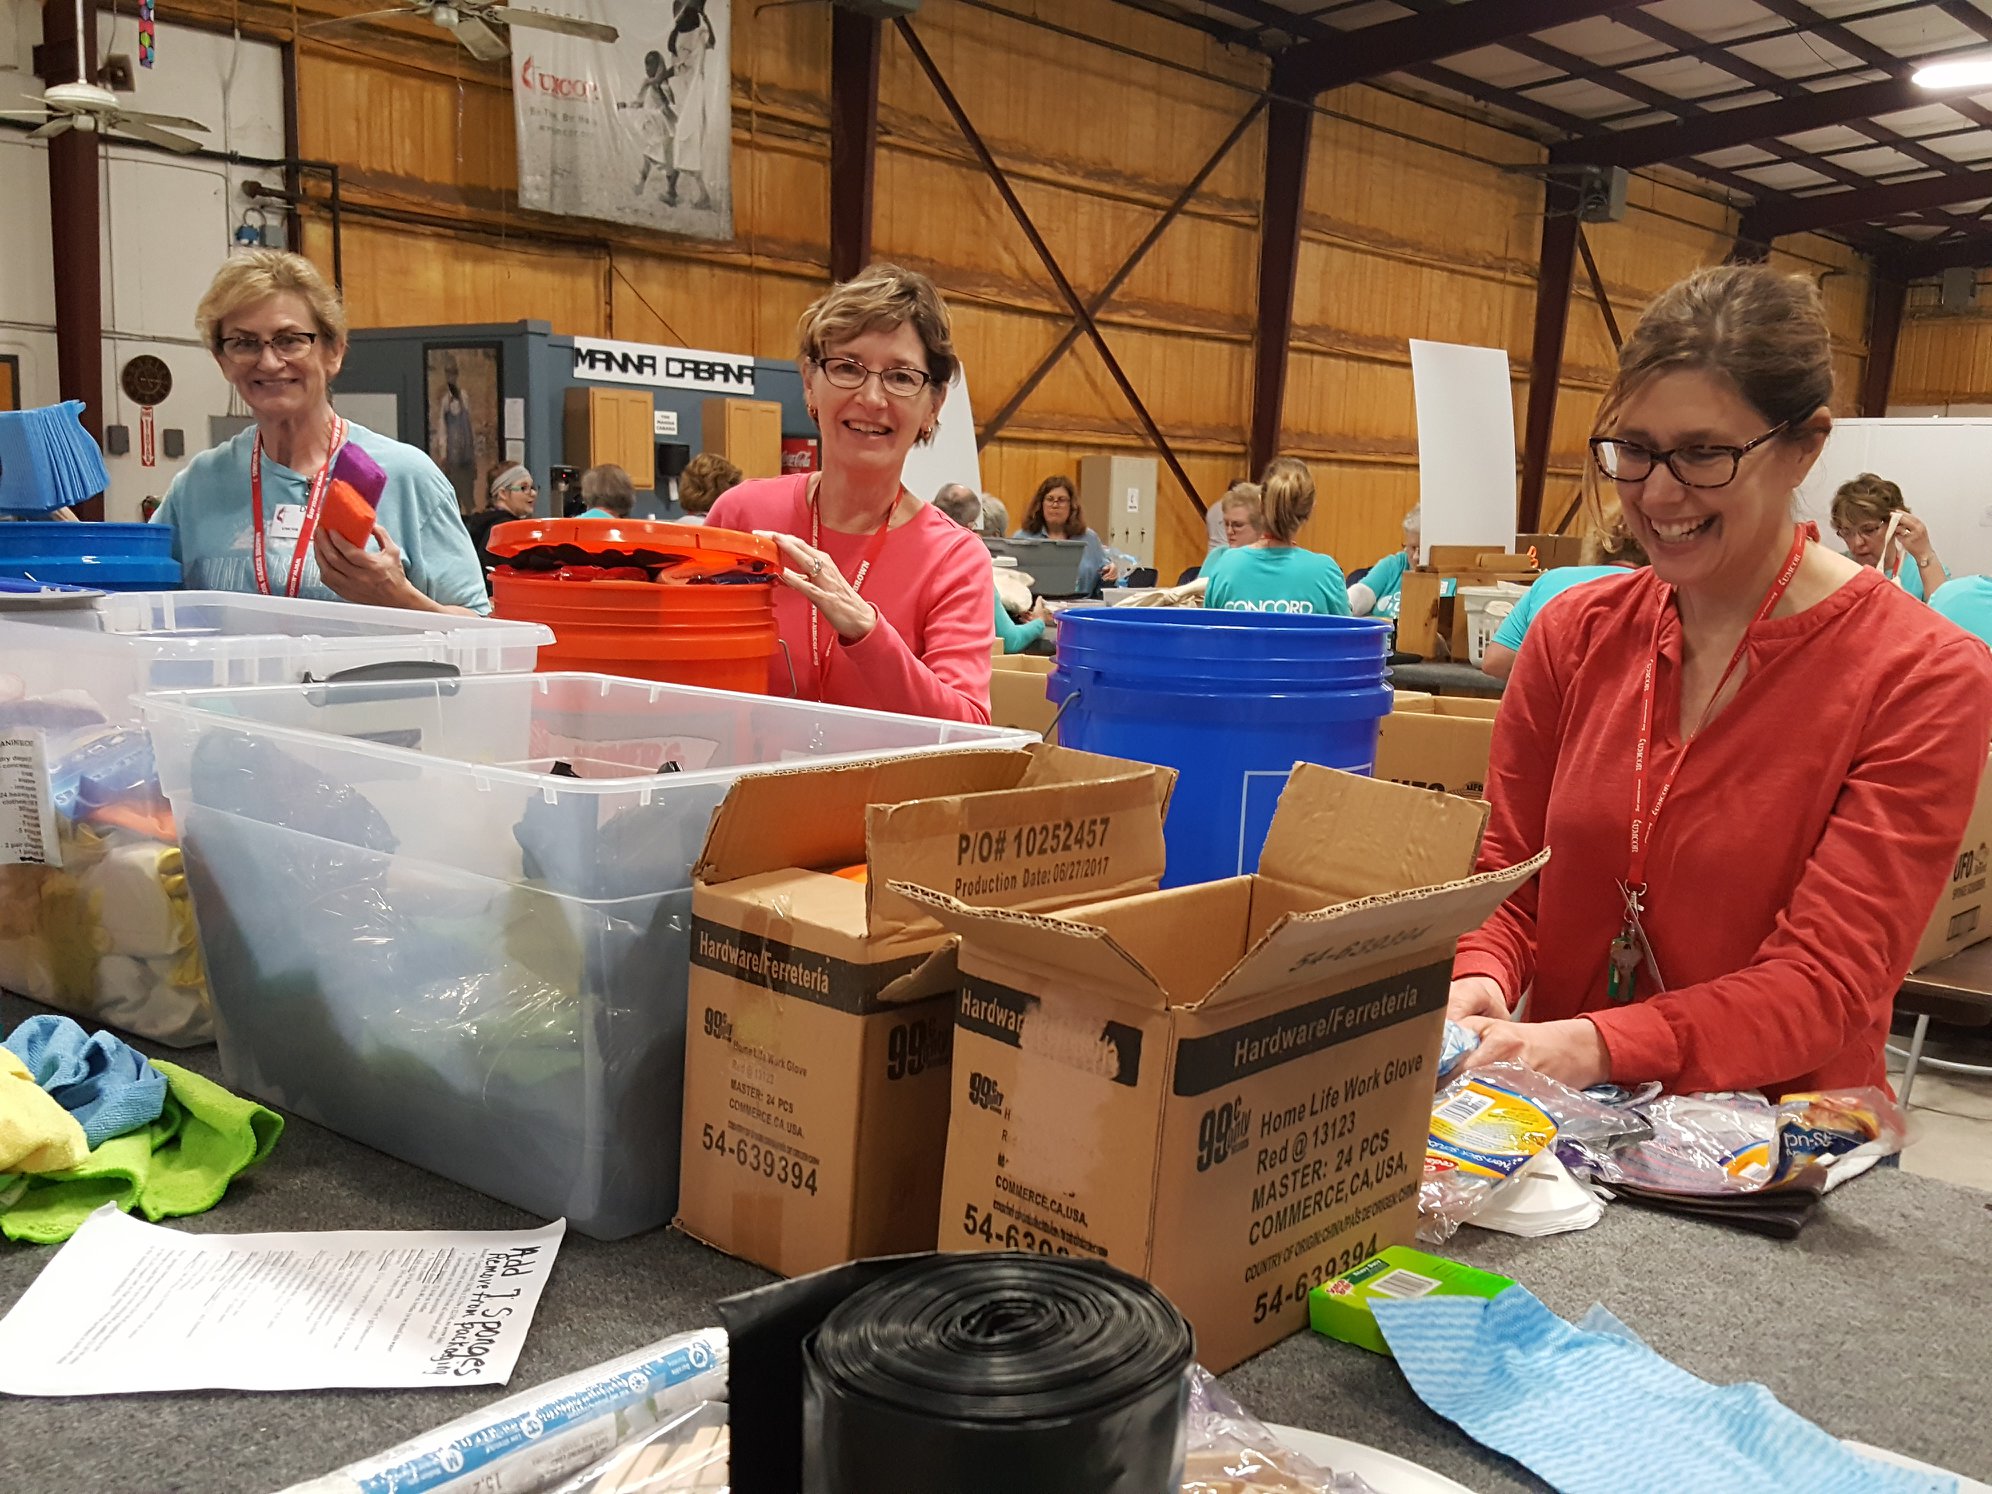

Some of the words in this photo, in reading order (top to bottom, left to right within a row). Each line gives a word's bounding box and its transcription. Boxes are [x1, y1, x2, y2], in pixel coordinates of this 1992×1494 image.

[574, 347, 656, 376] MANNA
[666, 357, 755, 385] CABANA
[1224, 599, 1314, 614] CONCORD
[957, 829, 1007, 866] P/O#
[1013, 817, 1111, 859] 10252457
[955, 872, 1017, 897] Production
[1023, 864, 1051, 889] Date:
[1053, 856, 1110, 883] 06/27/2017
[786, 1060, 807, 1077] Glove
[730, 1079, 763, 1101] MASTER:
[766, 1094, 775, 1106] 24
[778, 1097, 794, 1114] PCS
[1260, 1104, 1306, 1139] Home
[1309, 1086, 1340, 1117] Life
[1344, 1068, 1380, 1103] Work
[1384, 1054, 1424, 1086] Glove
[702, 1122, 818, 1197] 54-639394
[1256, 1139, 1289, 1175] Red
[1292, 1131, 1308, 1163] @
[1312, 1110, 1356, 1149] 13123
[1251, 1158, 1328, 1213] MASTER:
[1335, 1147, 1352, 1173] 24
[1359, 1128, 1390, 1162] PCS
[476, 1252, 510, 1289] Remove
[501, 1246, 541, 1277] Add
[1253, 1232, 1378, 1325] 54-639394
[462, 1291, 485, 1318] from
[452, 1306, 514, 1377] Sponges
